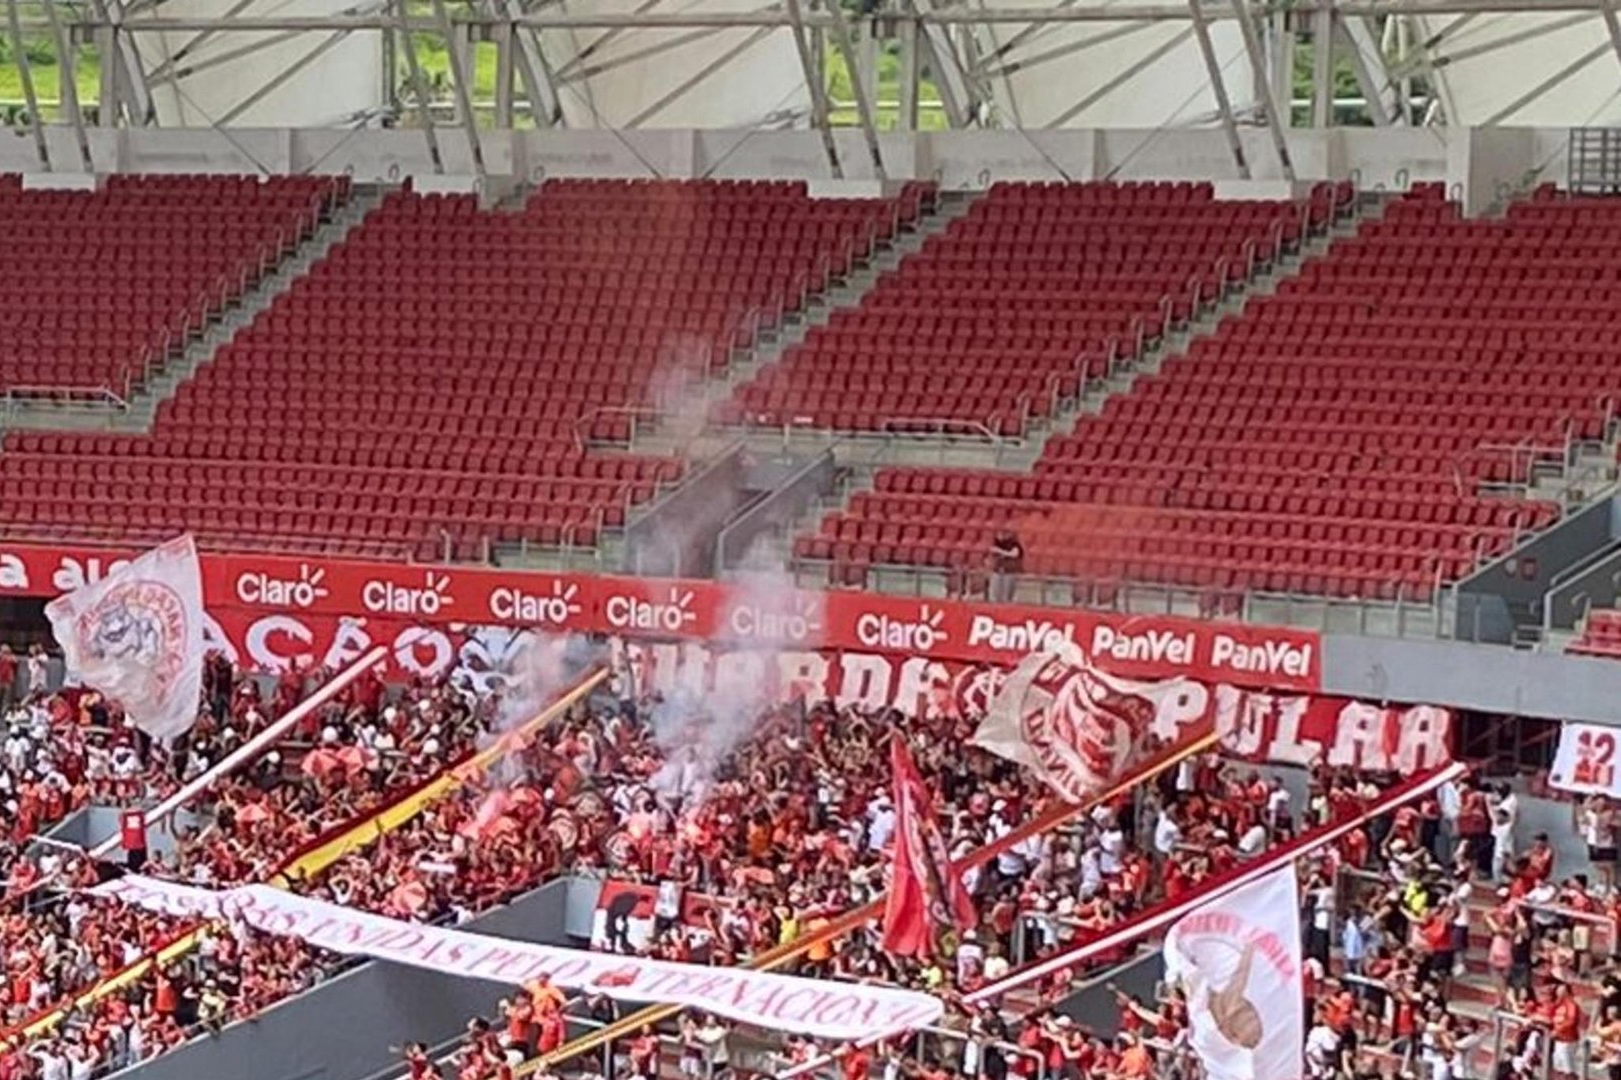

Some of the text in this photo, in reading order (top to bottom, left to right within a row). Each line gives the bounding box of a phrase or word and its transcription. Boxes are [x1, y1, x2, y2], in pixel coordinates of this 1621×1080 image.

[236, 572, 315, 607] Claro
[363, 580, 440, 615] Claro
[490, 588, 568, 623] Claro
[605, 596, 681, 630] Claro
[856, 613, 934, 649] Claro
[1091, 625, 1196, 665] PanVel
[1210, 636, 1311, 678] PanVel
